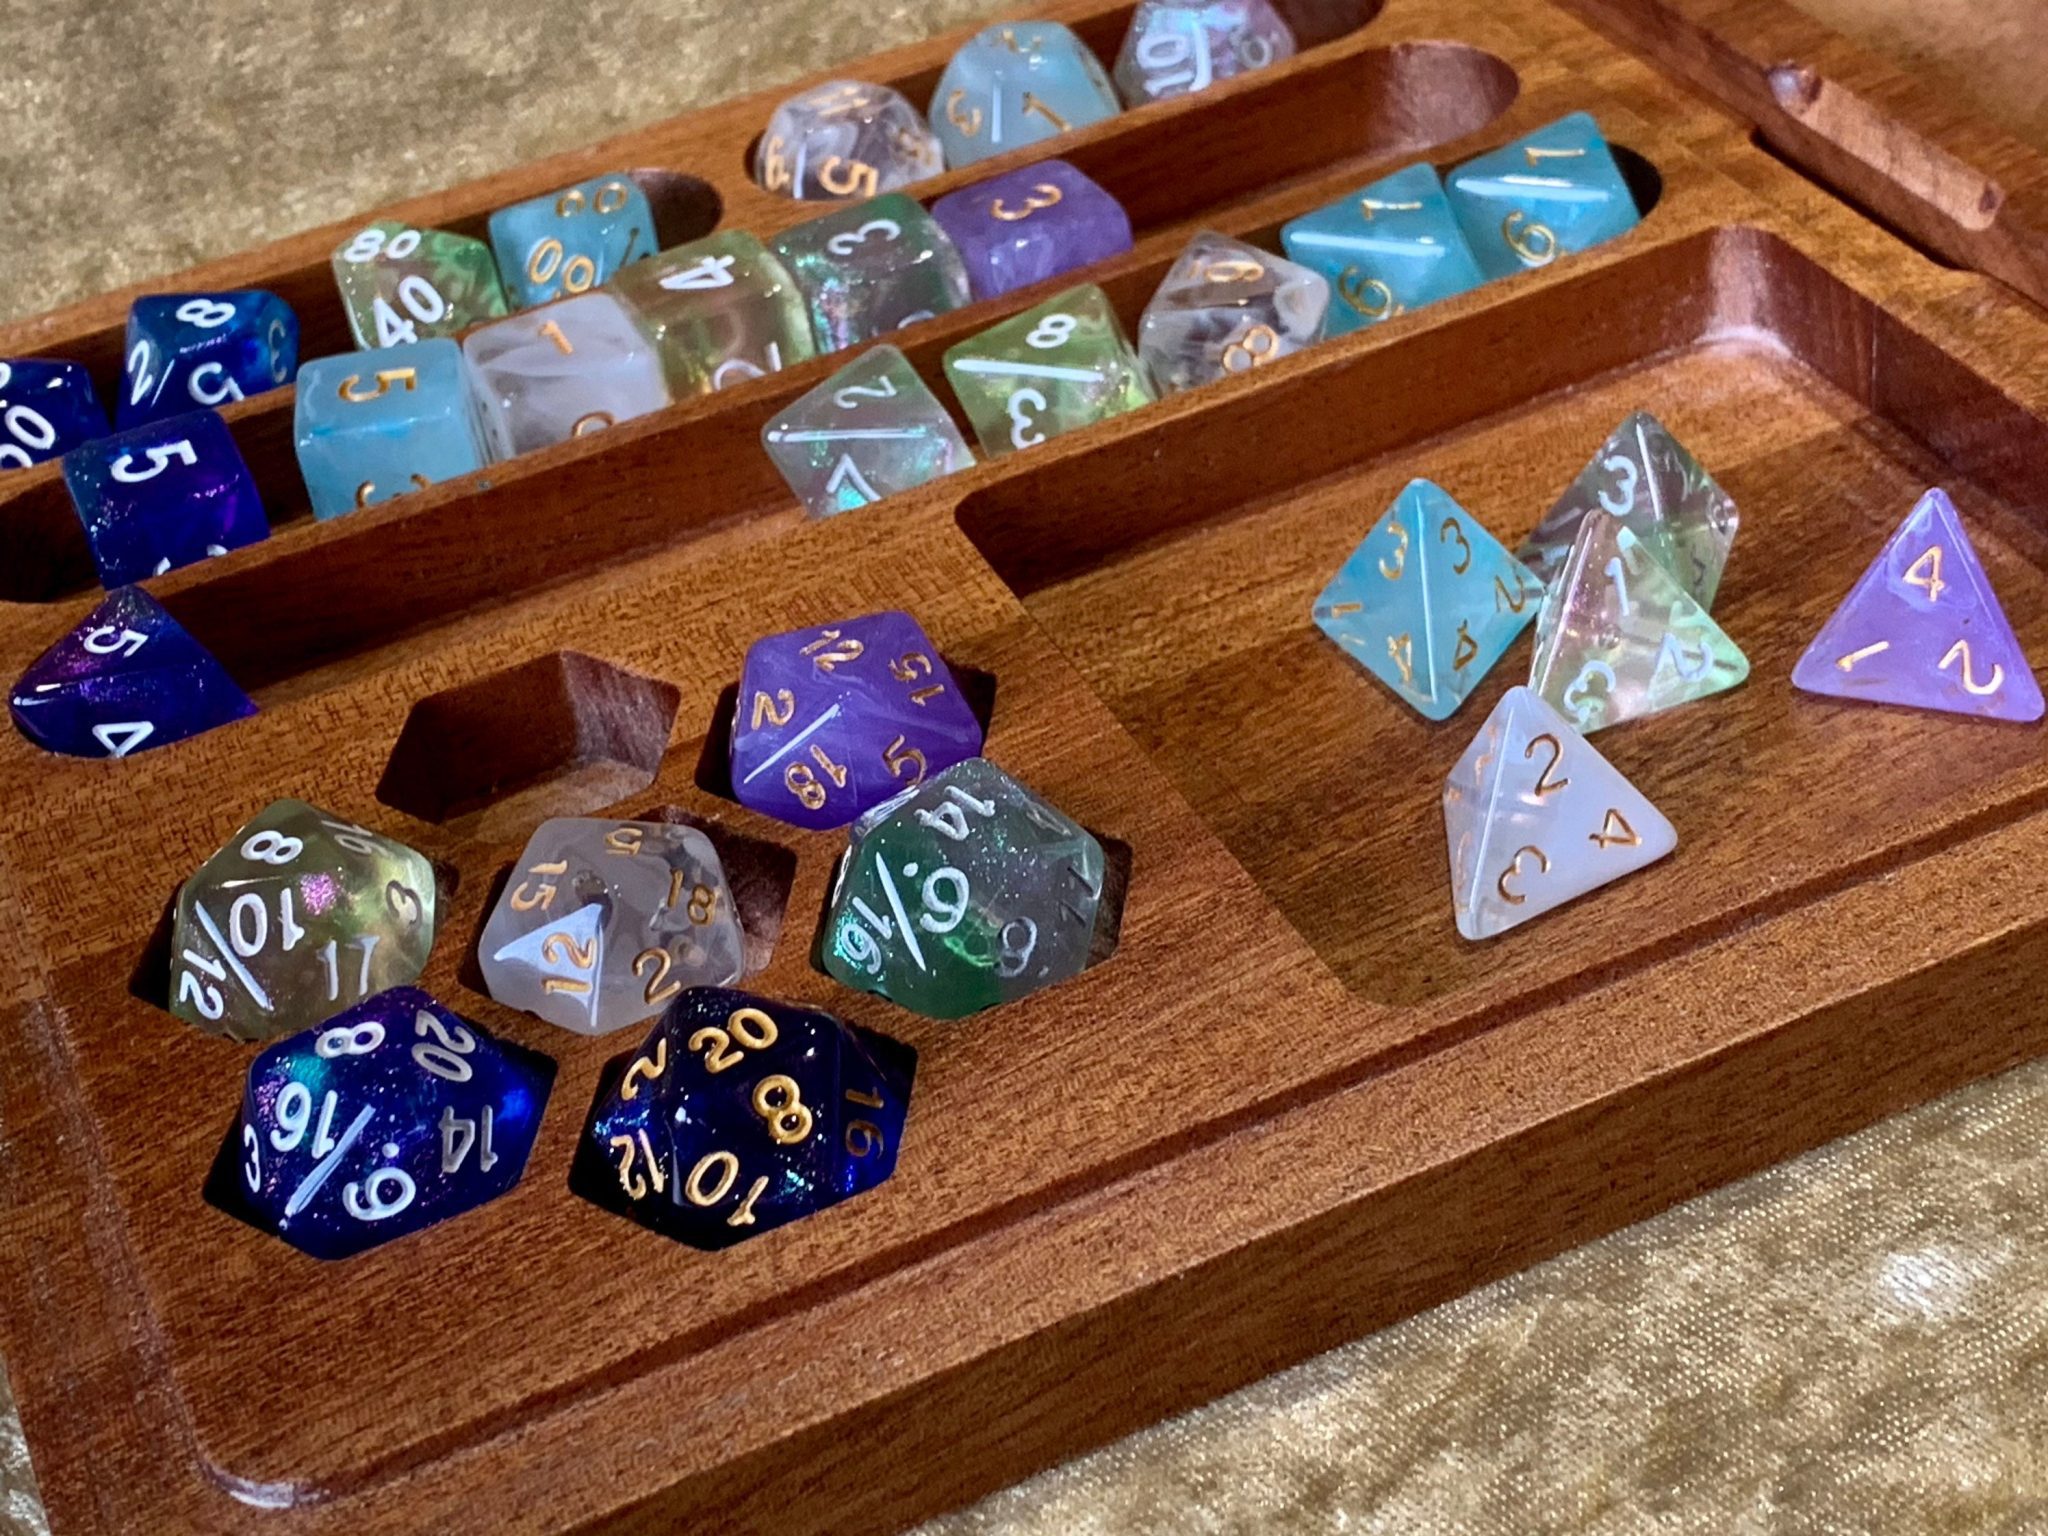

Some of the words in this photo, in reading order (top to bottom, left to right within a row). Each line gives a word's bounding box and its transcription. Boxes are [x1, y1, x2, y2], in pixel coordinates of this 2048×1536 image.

[819, 155, 879, 198] 5
[991, 183, 1063, 222] 3
[345, 229, 421, 263] 80
[828, 219, 901, 256] 3
[660, 255, 736, 290] 4
[175, 298, 236, 329] 8
[372, 274, 444, 349] 40
[538, 320, 573, 354] 1
[1026, 313, 1077, 349] 8
[127, 339, 153, 406] 2
[338, 366, 417, 402] 5
[834, 375, 898, 409] 2
[1008, 388, 1047, 450] 3
[110, 439, 198, 483] 5
[1598, 455, 1638, 516] 3
[1379, 523, 1409, 580] 3
[1440, 517, 1471, 575] 3
[1903, 545, 1945, 602] 4
[1605, 557, 1629, 616] 1
[800, 629, 865, 672] 12
[1454, 619, 1478, 671] 4
[1836, 640, 1890, 672] 1
[1938, 639, 2004, 695] 2
[888, 652, 945, 706] 15
[751, 688, 796, 730] 2
[784, 744, 847, 810] 18
[882, 734, 928, 786] 5
[1524, 733, 1572, 797] 2
[914, 786, 996, 841] 14
[1588, 808, 1642, 849] 4
[240, 830, 303, 866] 8
[1498, 844, 1551, 905] 3
[511, 860, 569, 913] 15
[667, 867, 719, 928] 18
[230, 888, 305, 957] 10
[179, 949, 227, 1020] 12
[542, 931, 597, 996] 12
[632, 946, 682, 1005] 2
[315, 1021, 387, 1059] 8
[412, 1010, 476, 1083] 20
[688, 1007, 779, 1075] 20
[621, 1037, 668, 1101] 2
[752, 1074, 814, 1144] 8
[845, 1086, 885, 1160] 16
[437, 1105, 499, 1173] 14
[609, 1128, 665, 1201] 12
[685, 1151, 769, 1227] 10
